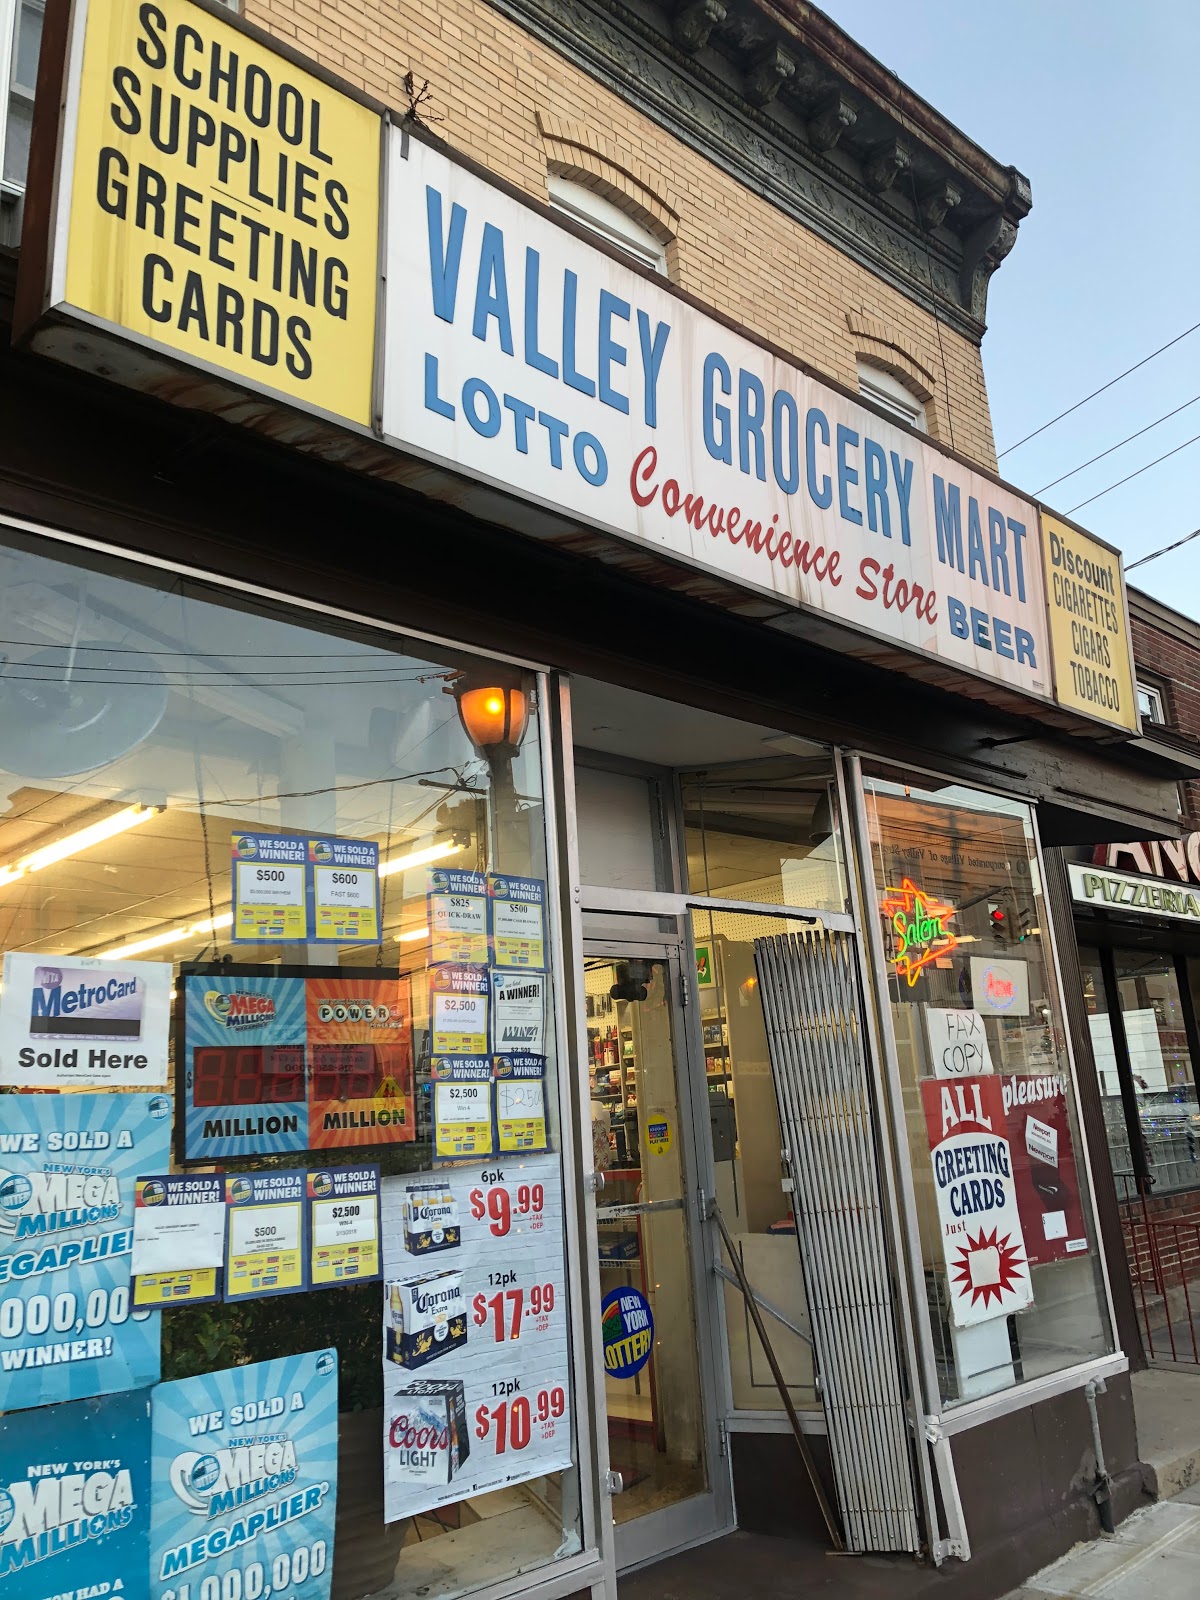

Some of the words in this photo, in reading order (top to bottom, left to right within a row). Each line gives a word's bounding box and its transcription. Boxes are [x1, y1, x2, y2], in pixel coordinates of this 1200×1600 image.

[137, 3, 333, 165] SCHOOL
[110, 66, 350, 240] SUPPLIES
[97, 147, 349, 321] GREETING
[142, 253, 313, 380] CARDS
[425, 184, 671, 429] VALLEY
[702, 352, 914, 546] GROCERY
[933, 473, 1027, 603] MART
[425, 352, 608, 487] LOTTO
[630, 445, 843, 587] Convenience
[855, 557, 938, 625] Store
[947, 595, 1037, 669] BEER
[1049, 531, 1115, 596] Discount
[1052, 571, 1119, 635] CIGARETTES
[1071, 620, 1111, 668] CIGARS
[1070, 661, 1120, 713] TOBACCO
[259, 840, 273, 848] WE
[274, 841, 297, 850] SOLD
[298, 842, 304, 850] A
[333, 845, 347, 853] WE
[348, 846, 368, 855] SOLD
[260, 849, 305, 860] WINNER!
[335, 854, 375, 865] WINNER!
[256, 870, 285, 882] $500
[332, 873, 358, 884] $600
[462, 875, 479, 884] SOLD
[451, 883, 485, 894] WINNER!
[509, 890, 541, 901] WINNER!
[520, 883, 536, 891] SOLD
[1083, 873, 1200, 917] PIZZERIA
[510, 904, 528, 913] $500
[893, 898, 943, 958] Salem
[41, 969, 59, 984] MTA
[452, 972, 462, 980] WE
[464, 972, 482, 981] SOLD
[452, 981, 488, 992] WINNER!
[499, 991, 505, 1000] A
[507, 984, 540, 1000] WINNER!
[31, 976, 137, 1017] MetroCard
[229, 994, 275, 1015] MEGA
[445, 1000, 476, 1012] $2,500
[225, 1013, 275, 1028] MILLIONS
[946, 1013, 981, 1041] FAX
[19, 1048, 78, 1068] Sold
[88, 1049, 148, 1069] Here
[453, 1060, 465, 1069] WE
[465, 1060, 484, 1068] SOLD
[485, 1060, 490, 1068] A
[513, 1058, 524, 1066] WE
[524, 1058, 537, 1066] SOLD
[943, 1043, 984, 1073] COPY
[453, 1069, 490, 1078] WINNER!
[514, 1067, 542, 1076] WINNER!
[449, 1088, 478, 1099] $2,500
[940, 1084, 992, 1138] ALL
[202, 1115, 298, 1139] MILLION
[322, 1108, 406, 1130] MILLION
[0, 1133, 39, 1153] WE
[48, 1131, 110, 1151] SOLD
[117, 1130, 134, 1148] A
[1028, 1143, 1056, 1163] Newport
[43, 1163, 74, 1173] NEW
[77, 1166, 112, 1176] YORK'S
[935, 1141, 1011, 1189] GREETING
[254, 1179, 269, 1189] WE
[269, 1178, 293, 1188] SOLD
[293, 1176, 301, 1186] A
[334, 1174, 348, 1183] WE
[348, 1172, 369, 1182] SOLD
[369, 1170, 376, 1180] A
[481, 1169, 505, 1185] 6pk
[22, 1173, 121, 1216] MEGA
[167, 1182, 186, 1193] WE
[187, 1181, 212, 1192] SOLD
[212, 1180, 220, 1190] A
[254, 1186, 302, 1201] WINNER!
[334, 1180, 376, 1195] WINNER!
[167, 1191, 220, 1205] WINNER!
[950, 1178, 1006, 1217] CARDS
[332, 1205, 360, 1218] $2,500
[420, 1206, 452, 1222] Corona
[469, 1184, 544, 1237] $9.99
[15, 1204, 119, 1241] MILLIONS
[530, 1222, 543, 1230] +DEP
[945, 1219, 967, 1236] Just
[254, 1226, 277, 1237] $500
[488, 1270, 517, 1287] 12pk
[416, 1286, 461, 1314] Corona
[620, 1295, 642, 1311] NEW
[431, 1305, 448, 1315] Extra
[472, 1283, 555, 1343] $17.99
[535, 1315, 549, 1323] +TAX
[623, 1309, 649, 1334] YORK
[535, 1324, 549, 1332] +DEP
[1, 1336, 112, 1371] WINNER!
[492, 1378, 521, 1397] 12pk
[189, 1410, 223, 1436] WE
[230, 1396, 284, 1426] SOLD
[291, 1391, 304, 1411] A
[475, 1387, 565, 1455] $10.99
[389, 1415, 449, 1450] Coors
[540, 1421, 555, 1431] +TAX
[229, 1436, 254, 1448] NEW
[257, 1433, 286, 1444] YORK'S
[541, 1430, 556, 1440] +DEP
[215, 1440, 297, 1492] MEGA
[399, 1450, 437, 1468] LIGHT
[27, 1462, 69, 1478] NEW
[73, 1459, 121, 1472] YORK'S
[208, 1468, 296, 1520] MILLIONS
[2, 1469, 134, 1543] MEGA
[0, 1505, 133, 1578] MILLIONS
[76, 1582, 111, 1600] HAD
[112, 1578, 124, 1591] A
